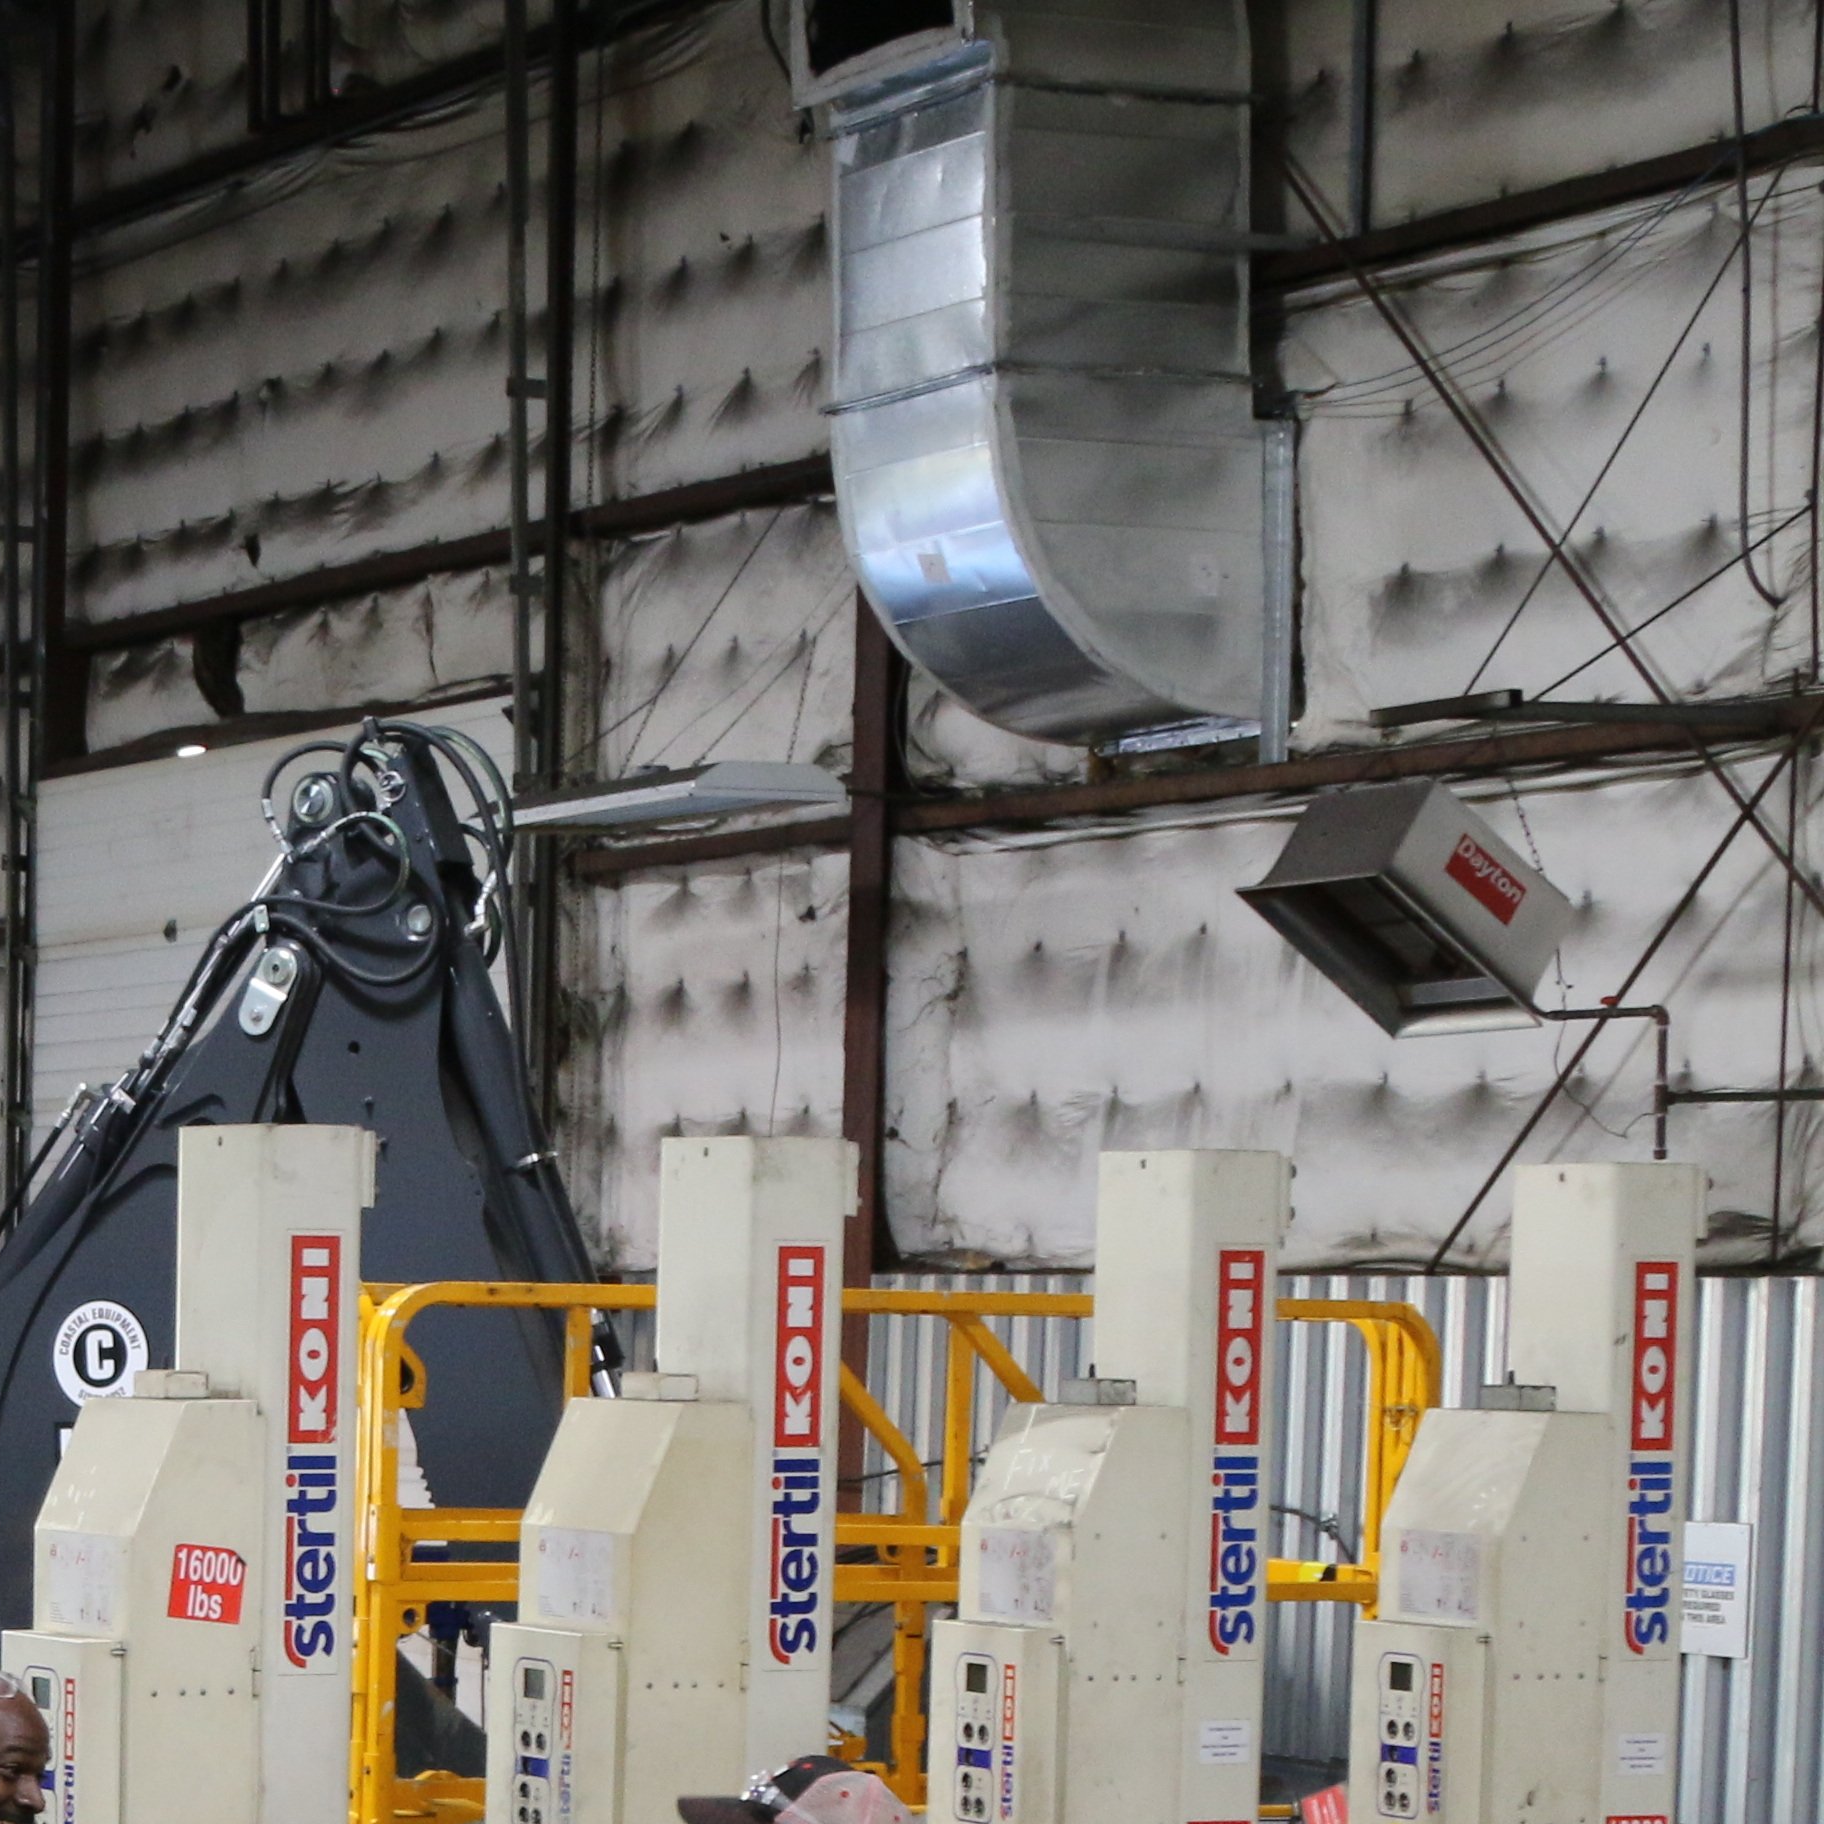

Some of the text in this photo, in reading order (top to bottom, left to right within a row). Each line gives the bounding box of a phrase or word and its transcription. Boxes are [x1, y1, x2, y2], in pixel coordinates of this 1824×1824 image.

[1455, 837, 1523, 903] Dayton
[59, 1307, 142, 1356] COASTAL EQUIPMENT
[84, 1328, 116, 1381] C
[284, 1244, 337, 1668] stertil KONI
[769, 1254, 820, 1665] stertil KONI
[1209, 1258, 1259, 1655] stertil KONI
[1625, 1270, 1674, 1656] stertil KONI
[177, 1547, 243, 1586] 16000
[1683, 1564, 1734, 1585] OTICE
[186, 1583, 223, 1620] lbs
